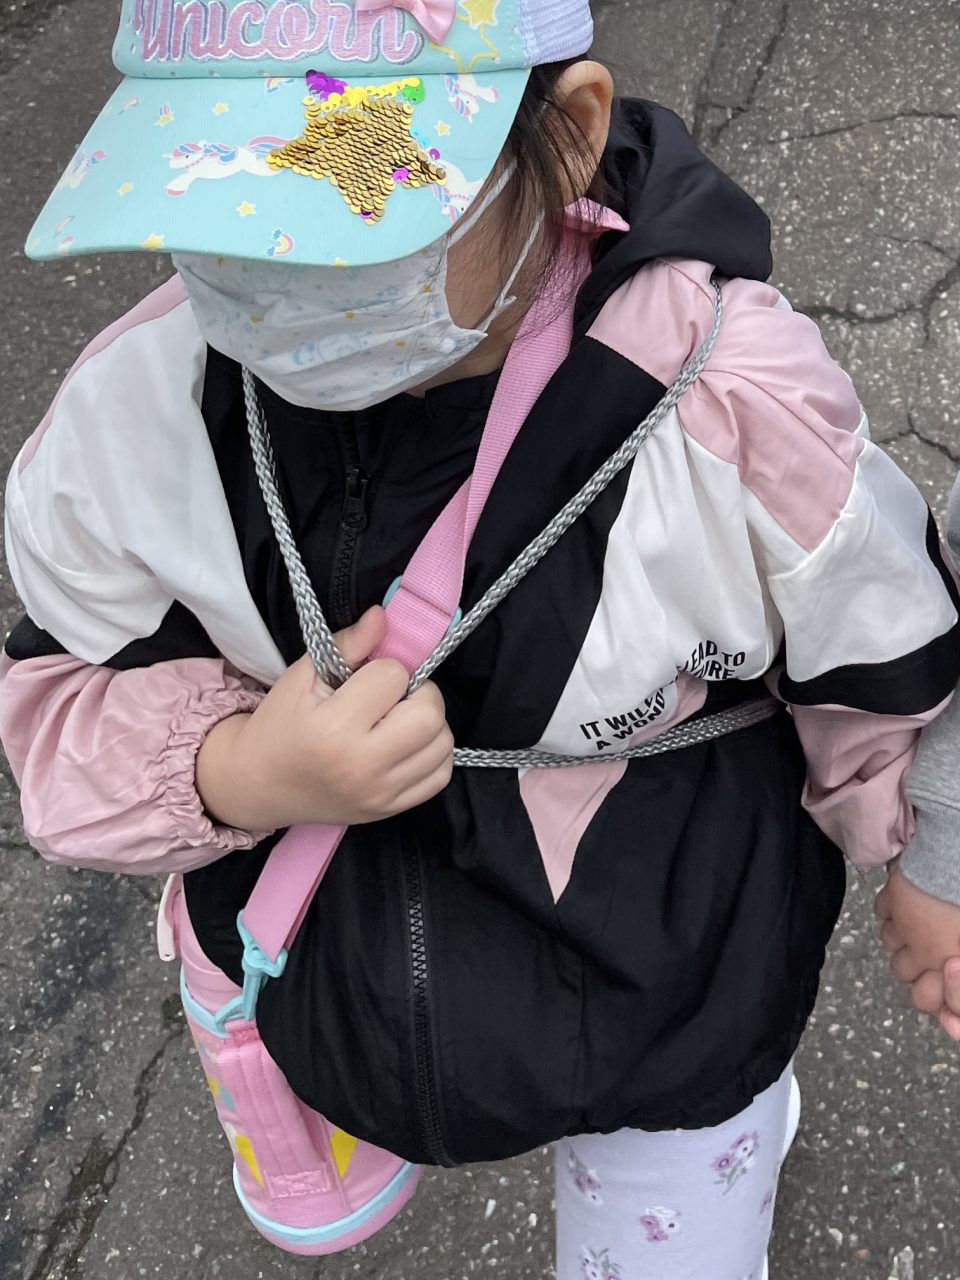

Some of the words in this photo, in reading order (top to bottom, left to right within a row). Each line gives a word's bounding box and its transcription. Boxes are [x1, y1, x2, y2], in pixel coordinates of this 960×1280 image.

[580, 721, 603, 740] IT
[721, 651, 746, 667] TO
[596, 740, 612, 751] A
